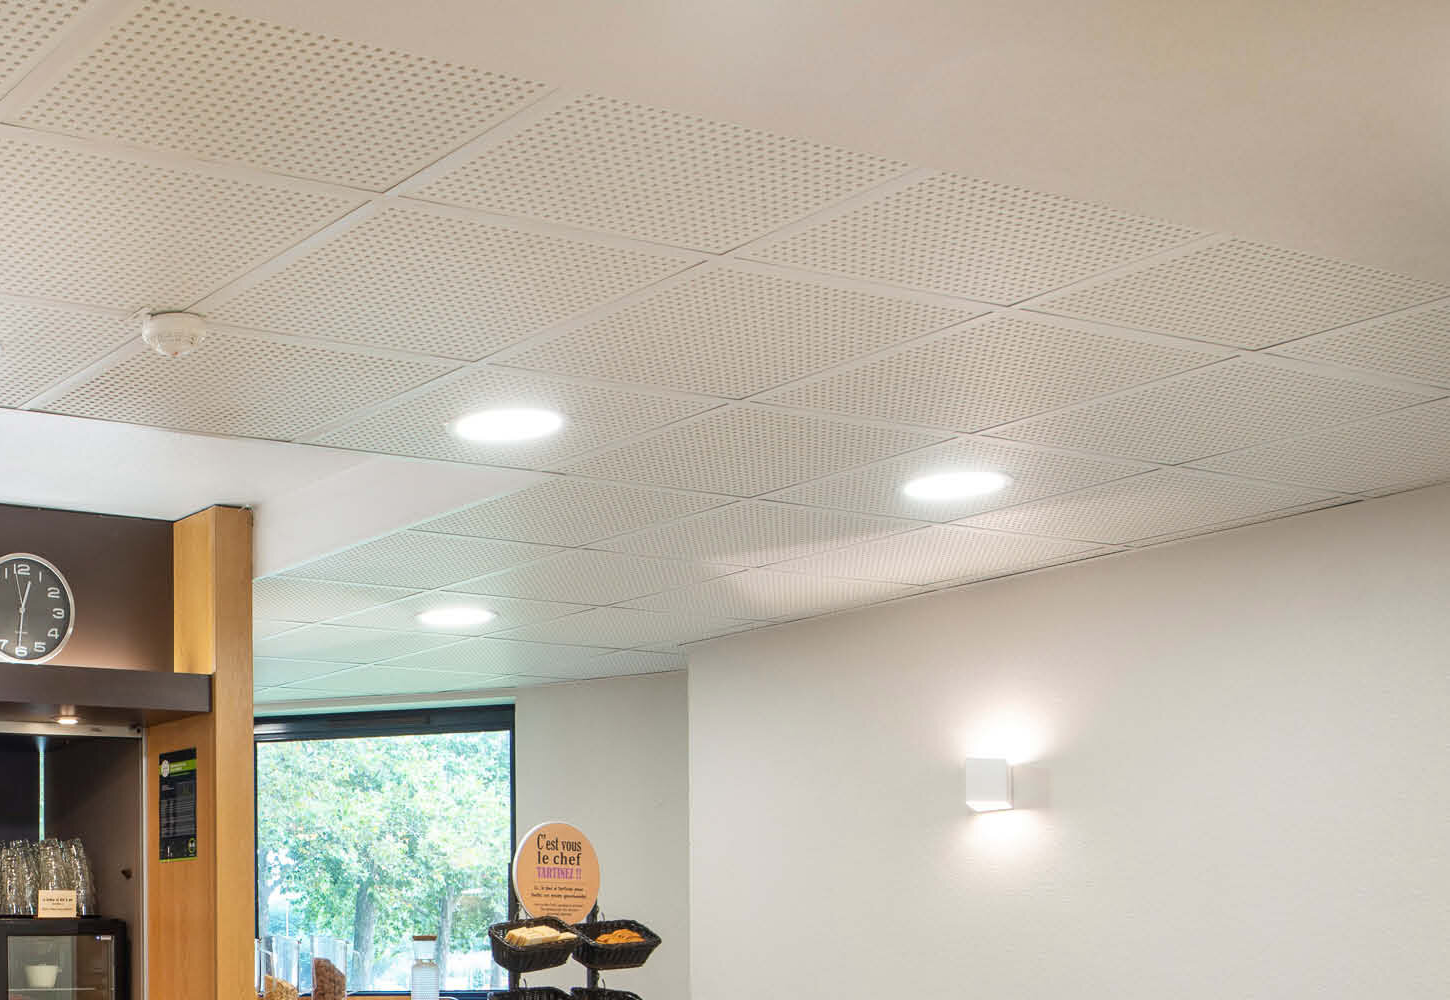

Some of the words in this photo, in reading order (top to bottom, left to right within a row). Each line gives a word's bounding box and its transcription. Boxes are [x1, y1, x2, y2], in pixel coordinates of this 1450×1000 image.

[13, 563, 31, 575] 12
[38, 571, 43, 583] 1
[47, 586, 60, 599] 2
[52, 607, 65, 619] 3
[47, 628, 60, 640] 4
[14, 646, 28, 657] 6
[33, 641, 46, 653] 5
[536, 833, 559, 851] C'est
[561, 840, 582, 852] vous
[537, 851, 550, 865] le
[553, 851, 582, 866] chef
